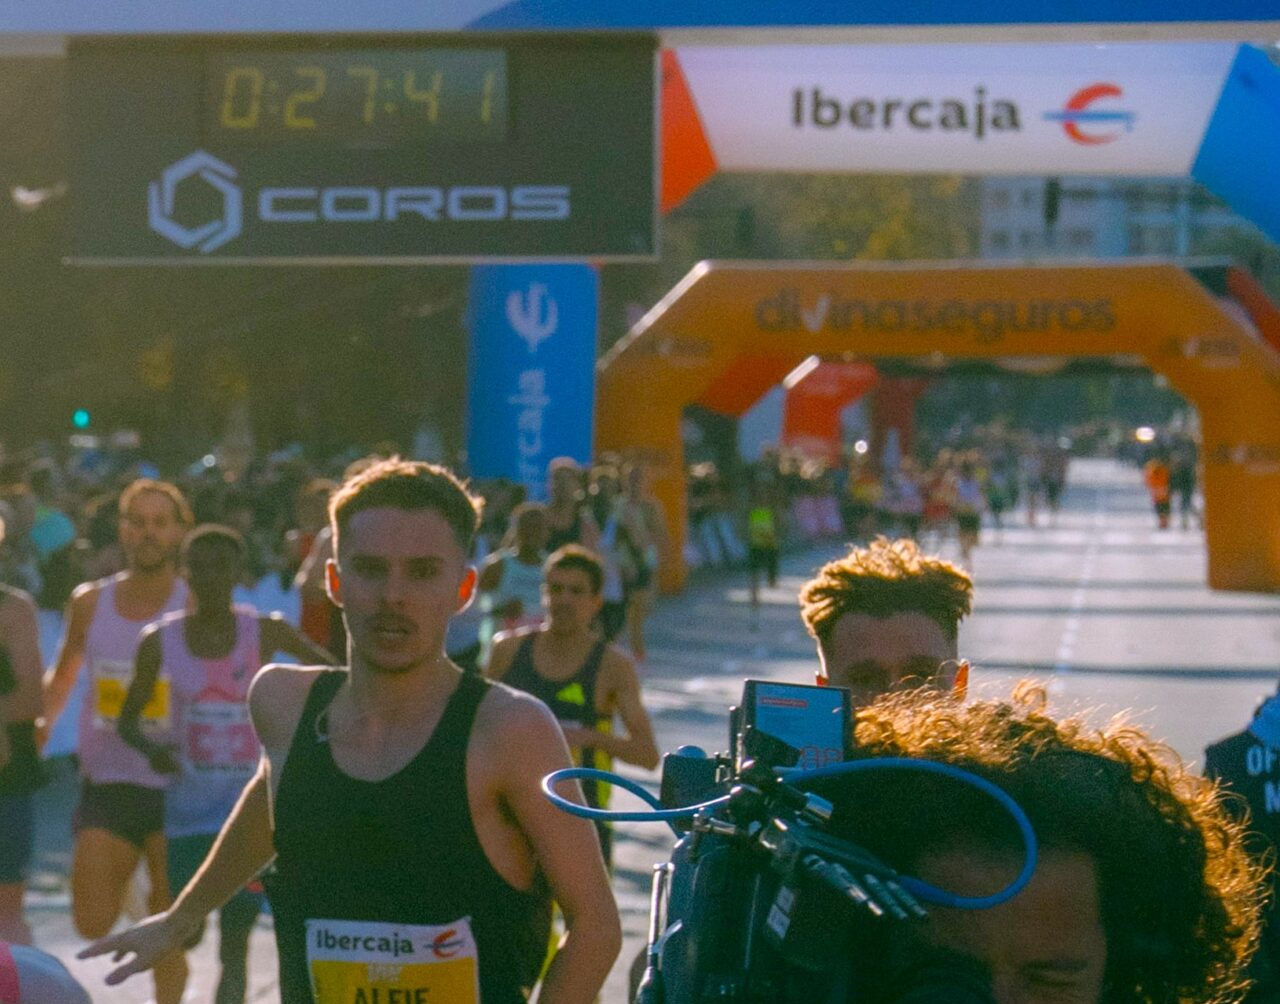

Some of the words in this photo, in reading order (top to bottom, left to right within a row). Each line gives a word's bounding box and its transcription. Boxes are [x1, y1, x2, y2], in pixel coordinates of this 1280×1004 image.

[792, 85, 1023, 140] Ibercaja
[258, 185, 571, 222] COROS
[316, 929, 415, 957] Ibercaja
